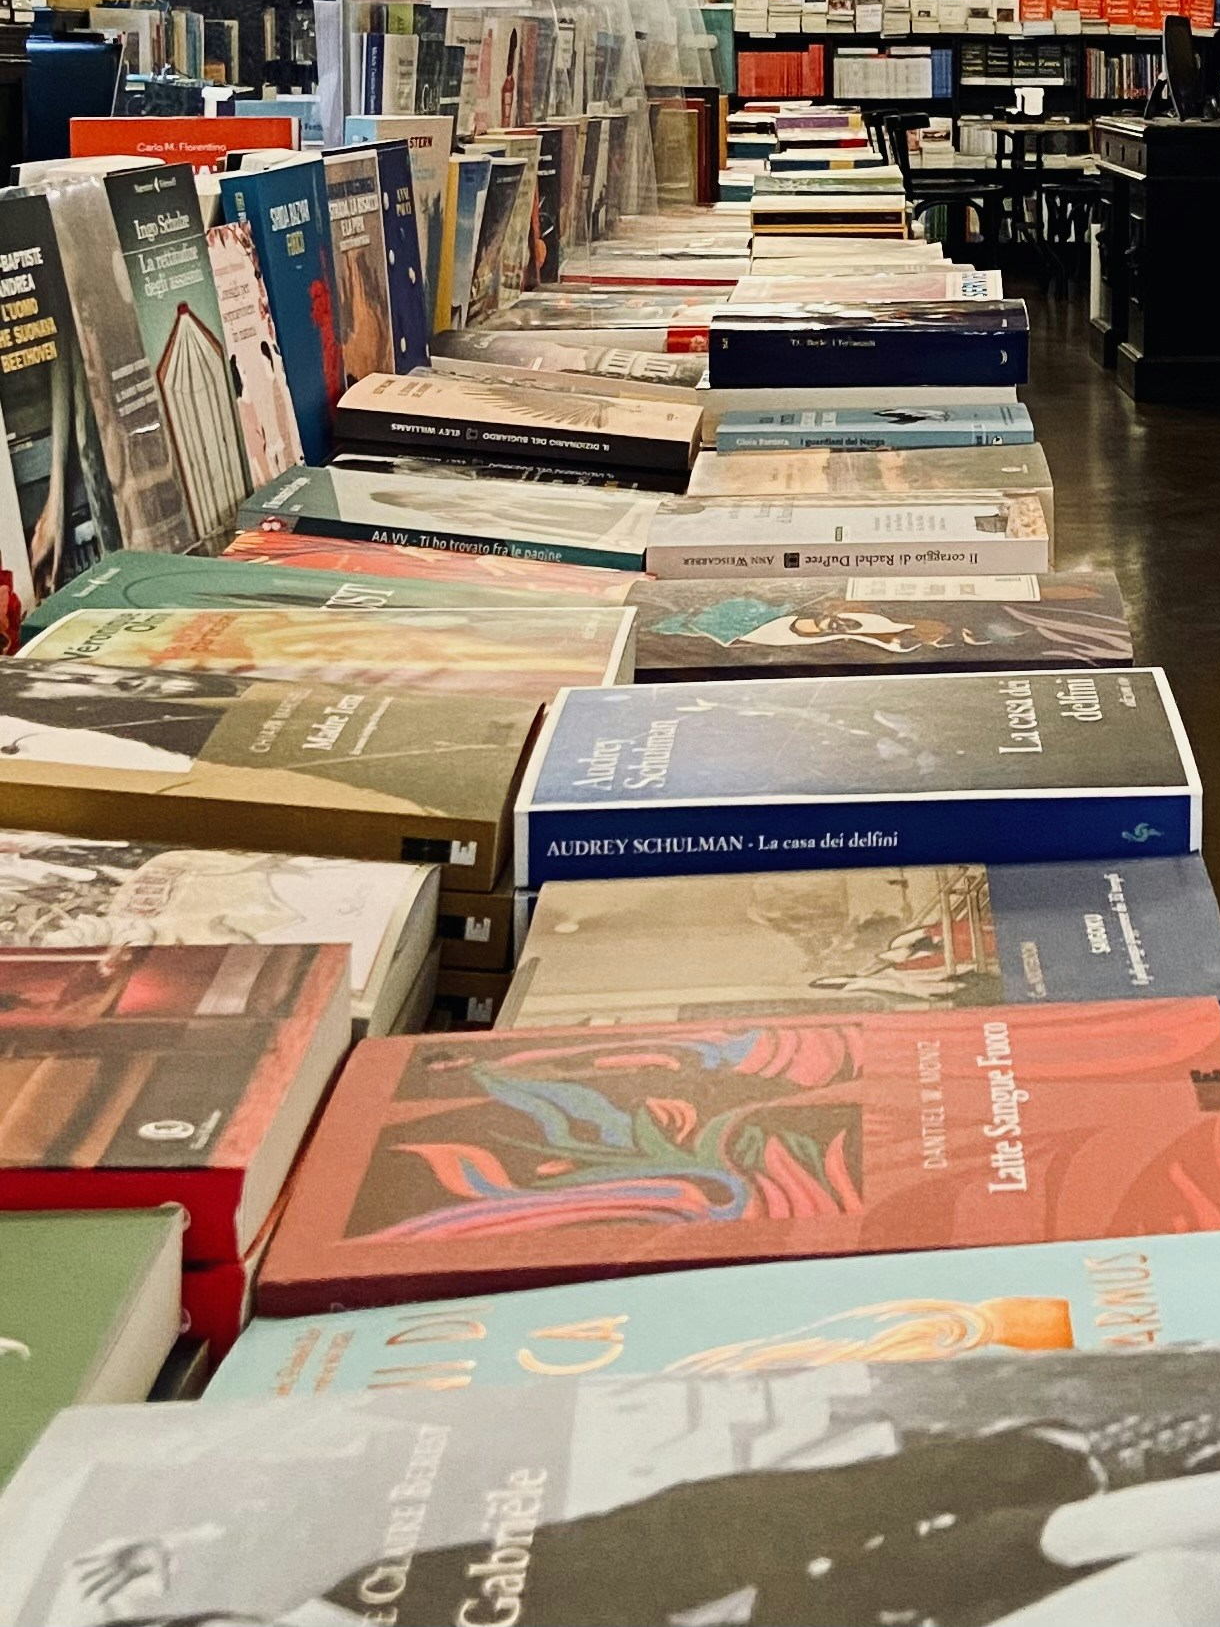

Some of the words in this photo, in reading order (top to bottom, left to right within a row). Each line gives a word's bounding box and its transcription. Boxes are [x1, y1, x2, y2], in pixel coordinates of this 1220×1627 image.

[136, 142, 164, 152] Carlo
[179, 142, 227, 152] Fiorentino
[134, 218, 156, 243] Ingo
[138, 253, 155, 275] La
[144, 273, 169, 301] degli
[530, 436, 548, 446] DEL
[549, 438, 600, 451] DIZIONARIO
[371, 530, 410, 547] AA.VV.
[419, 535, 431, 548] Ti
[431, 536, 448, 550] ho
[449, 537, 491, 556] trovato
[492, 540, 509, 557] fra
[511, 542, 523, 558] le
[804, 555, 852, 566] DuPree
[854, 553, 895, 566] Rachel
[899, 553, 912, 566] di
[914, 551, 966, 563] coraggio
[968, 552, 979, 564] Il
[998, 679, 1032, 697] dei
[1056, 678, 1103, 722] delfini
[1004, 697, 1038, 729] casa
[622, 718, 680, 790] Schulman
[998, 730, 1043, 754] La
[586, 736, 626, 791] Audrey
[546, 837, 629, 858] AUDREY
[632, 834, 743, 855] SCHULMAN
[757, 834, 780, 851] La
[782, 837, 816, 851] casa
[820, 831, 846, 850] dei
[848, 829, 899, 850] delfini
[975, 1020, 1013, 1068] Fuoco
[982, 1068, 1031, 1138] Sangue
[987, 1138, 1028, 1195] Latte
[455, 1467, 549, 1627] Gabriële
